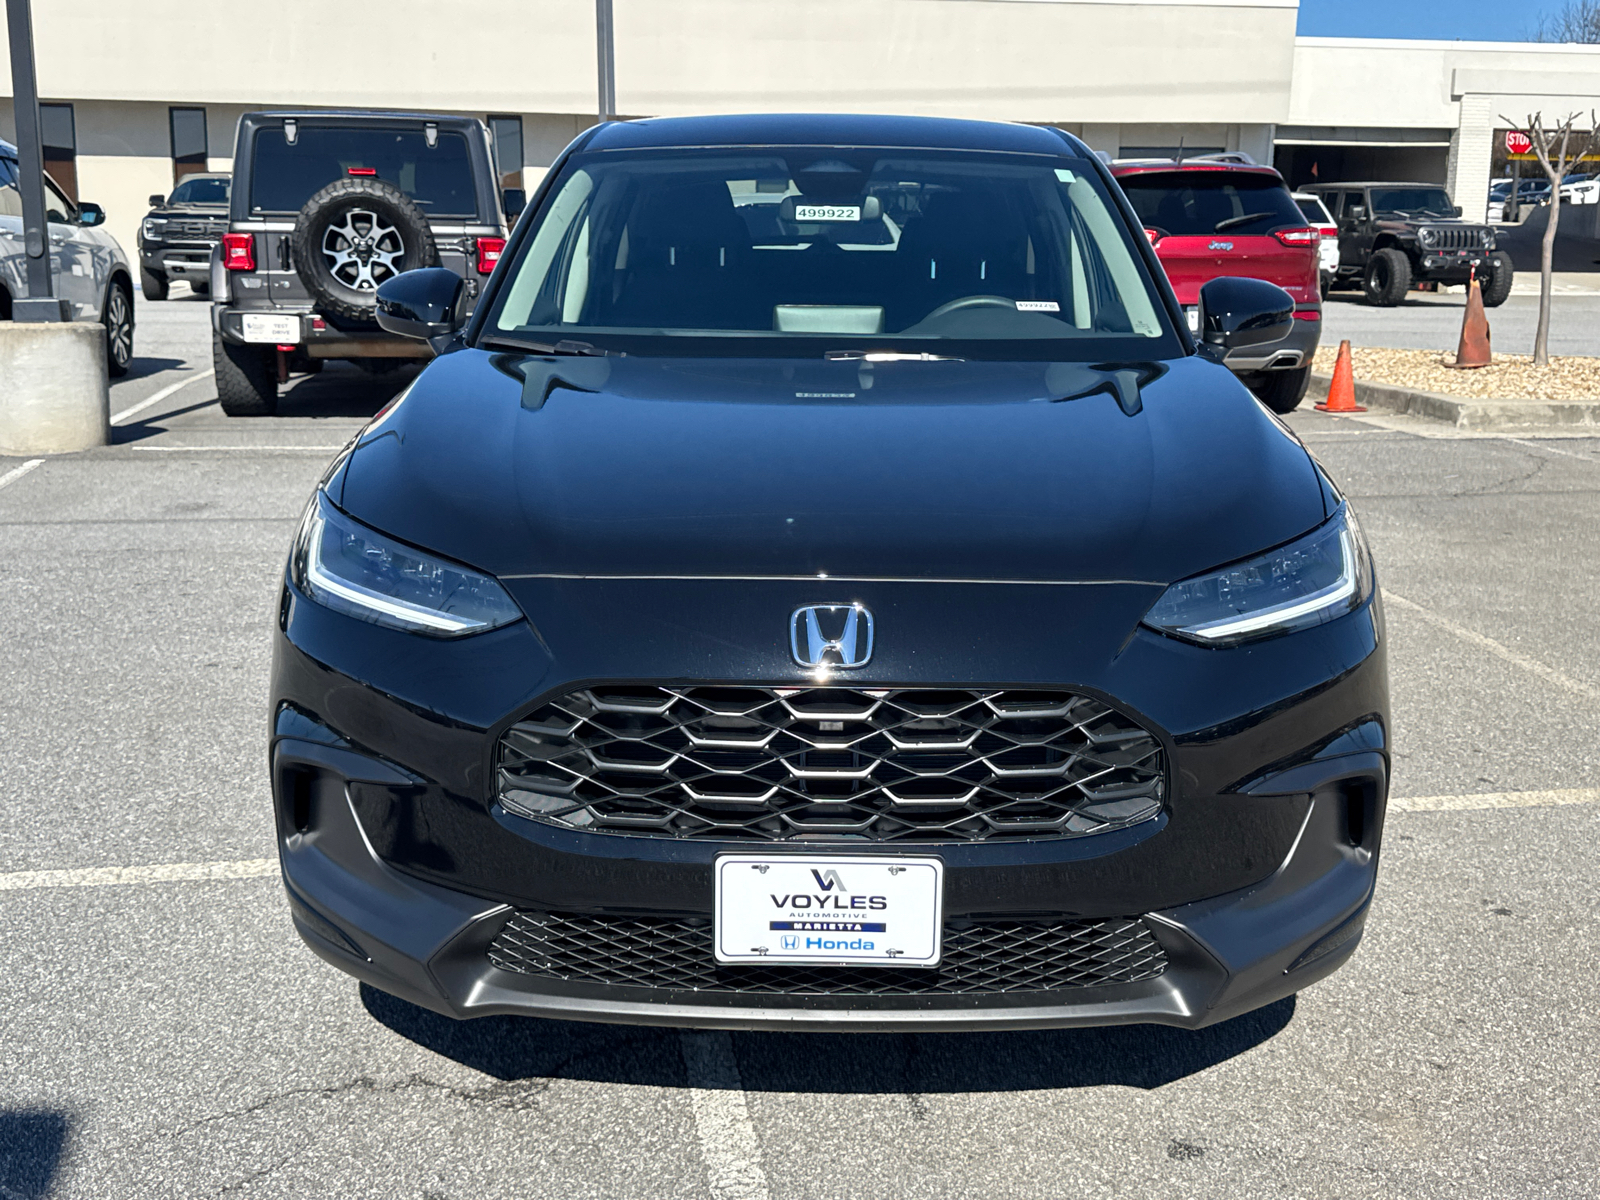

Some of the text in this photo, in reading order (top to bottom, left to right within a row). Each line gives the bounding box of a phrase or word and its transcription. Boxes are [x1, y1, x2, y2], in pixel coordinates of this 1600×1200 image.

[798, 208, 855, 218] 499922
[1208, 240, 1234, 251] Jeep
[769, 893, 888, 910] VOYLES
[793, 922, 862, 931] MARIETTA
[806, 937, 875, 951] Honda
